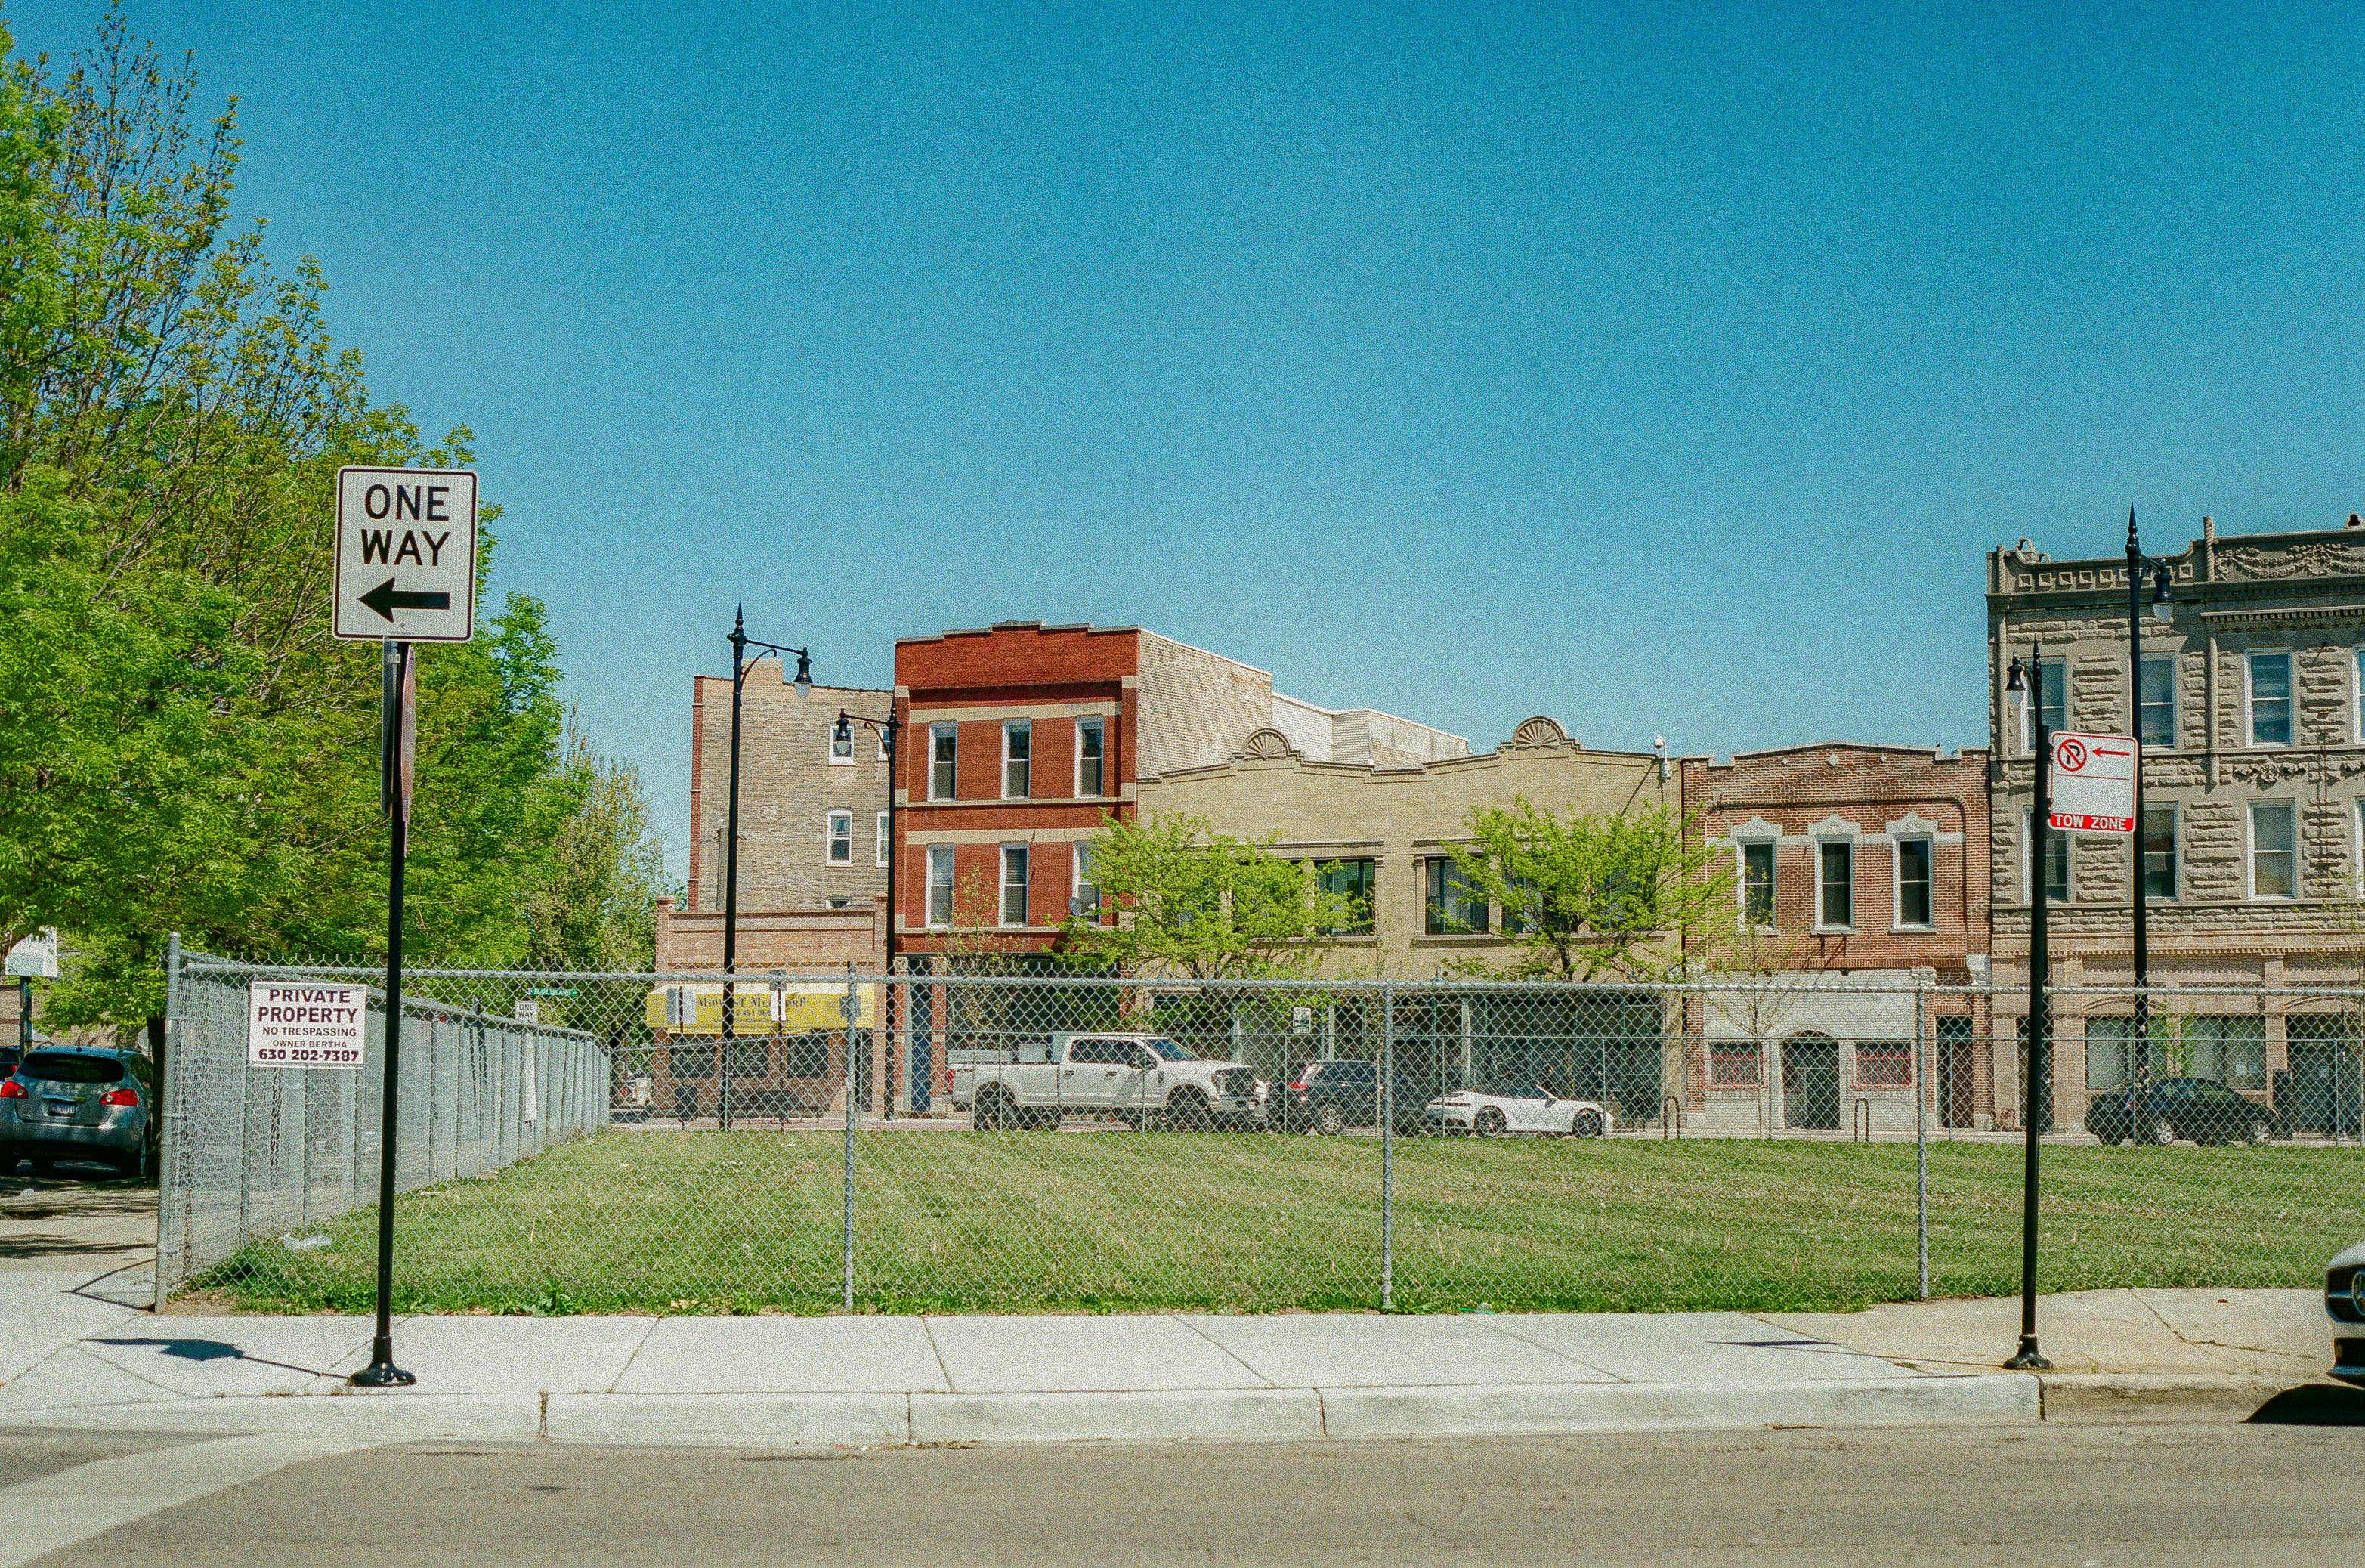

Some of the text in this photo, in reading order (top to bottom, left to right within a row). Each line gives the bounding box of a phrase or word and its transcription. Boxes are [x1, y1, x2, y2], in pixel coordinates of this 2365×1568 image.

[365, 484, 450, 521] ONE
[361, 529, 451, 567] WAY
[2055, 814, 2127, 830] TOW ZONE
[269, 989, 351, 1004] PRIVATE
[258, 1007, 359, 1024] PROPERTY
[262, 1027, 357, 1037] NO TRESPASSING
[308, 1041, 348, 1049] BERTHA
[258, 1049, 359, 1062] 630 202-7387
